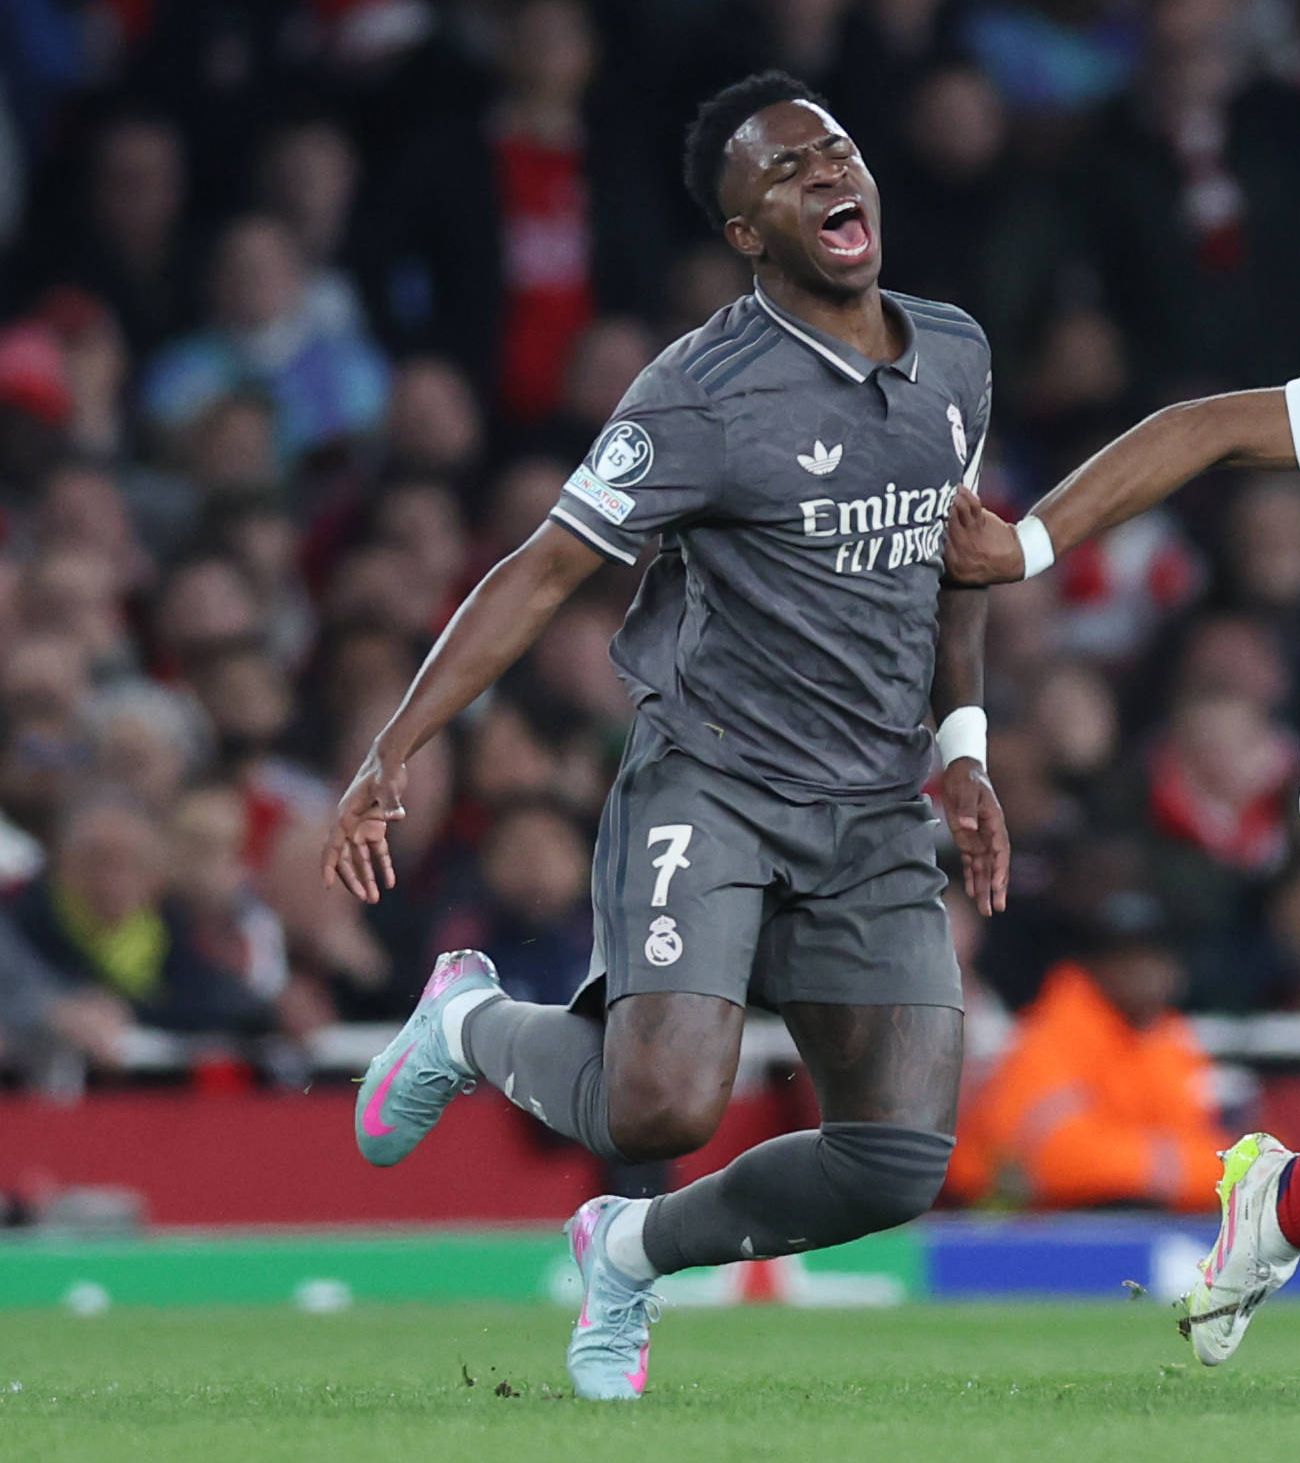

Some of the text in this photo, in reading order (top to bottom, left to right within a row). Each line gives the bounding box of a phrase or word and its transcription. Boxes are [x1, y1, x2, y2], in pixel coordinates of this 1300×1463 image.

[607, 448, 626, 467] 15
[799, 479, 958, 537] Emirate
[835, 536, 885, 573] FLY
[647, 824, 693, 907] 7
